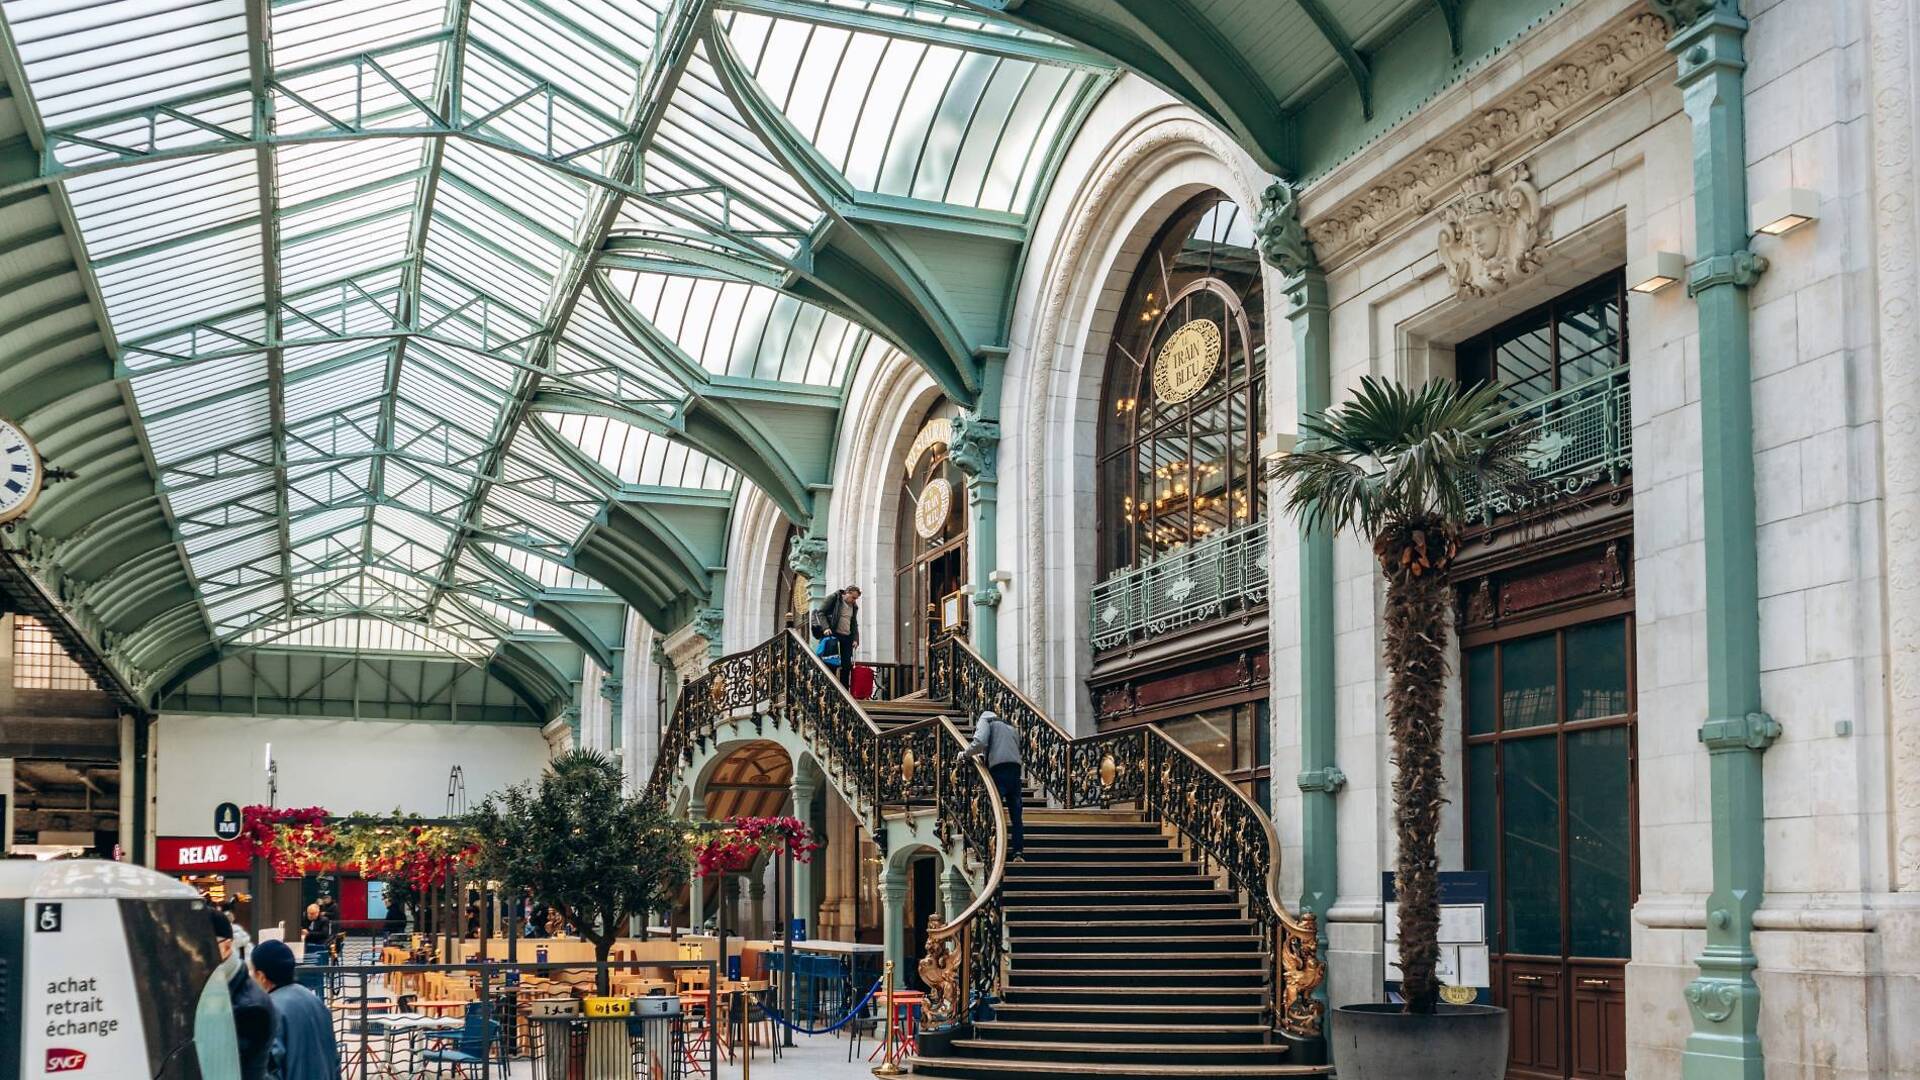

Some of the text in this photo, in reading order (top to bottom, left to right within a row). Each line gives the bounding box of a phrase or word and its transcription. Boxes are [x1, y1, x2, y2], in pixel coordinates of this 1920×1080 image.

[1173, 340, 1200, 369] TRAIN
[1176, 360, 1200, 387] BLEU
[46, 977, 97, 994] achat
[46, 997, 104, 1015] retrait
[45, 1019, 119, 1037] échange
[46, 1055, 84, 1072] SNCF
